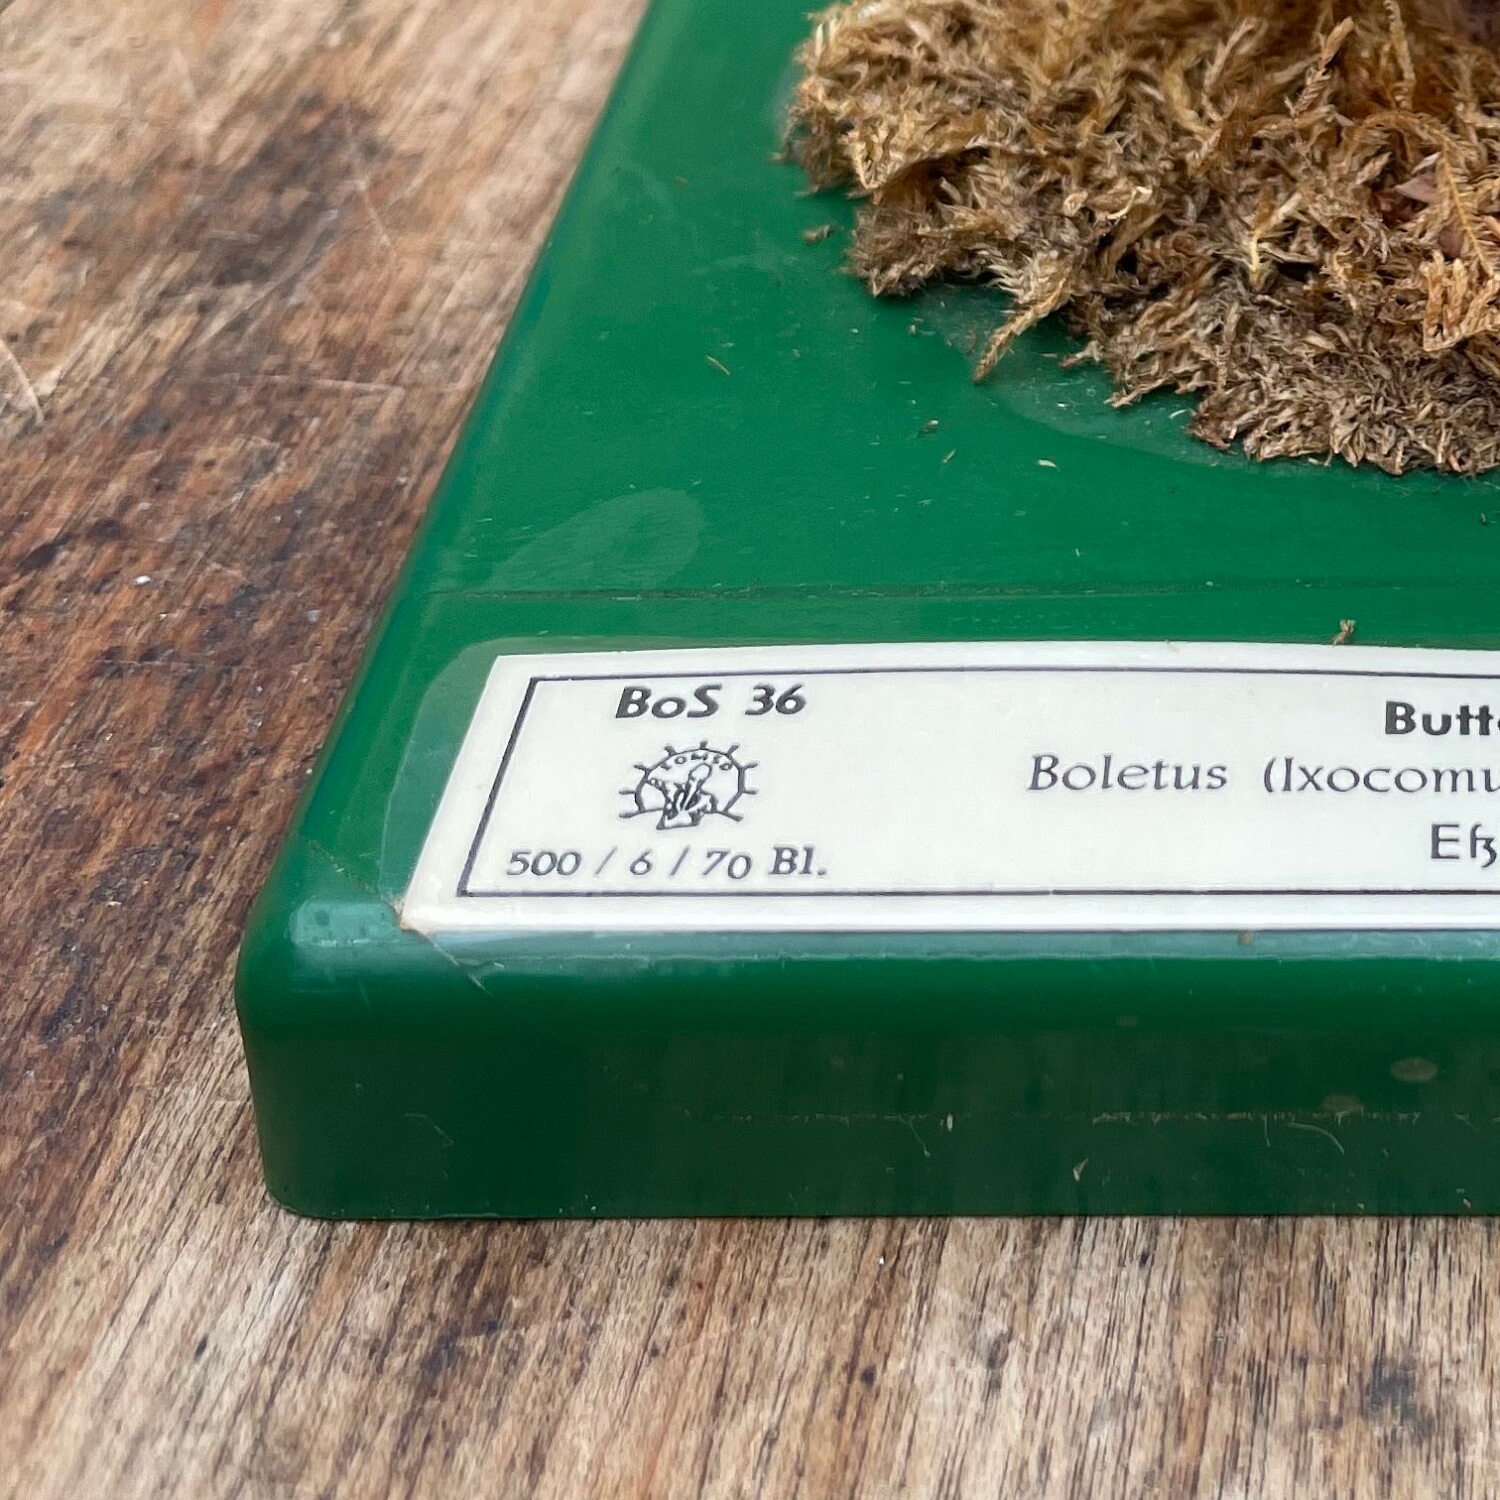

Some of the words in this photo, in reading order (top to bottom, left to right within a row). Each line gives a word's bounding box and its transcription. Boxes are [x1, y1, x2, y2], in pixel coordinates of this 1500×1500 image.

[615, 684, 723, 719] BoS
[744, 683, 807, 717] 36
[1027, 753, 1228, 791] Boletus
[505, 848, 582, 877] 500
[628, 849, 654, 877] 6
[702, 847, 753, 880] 70
